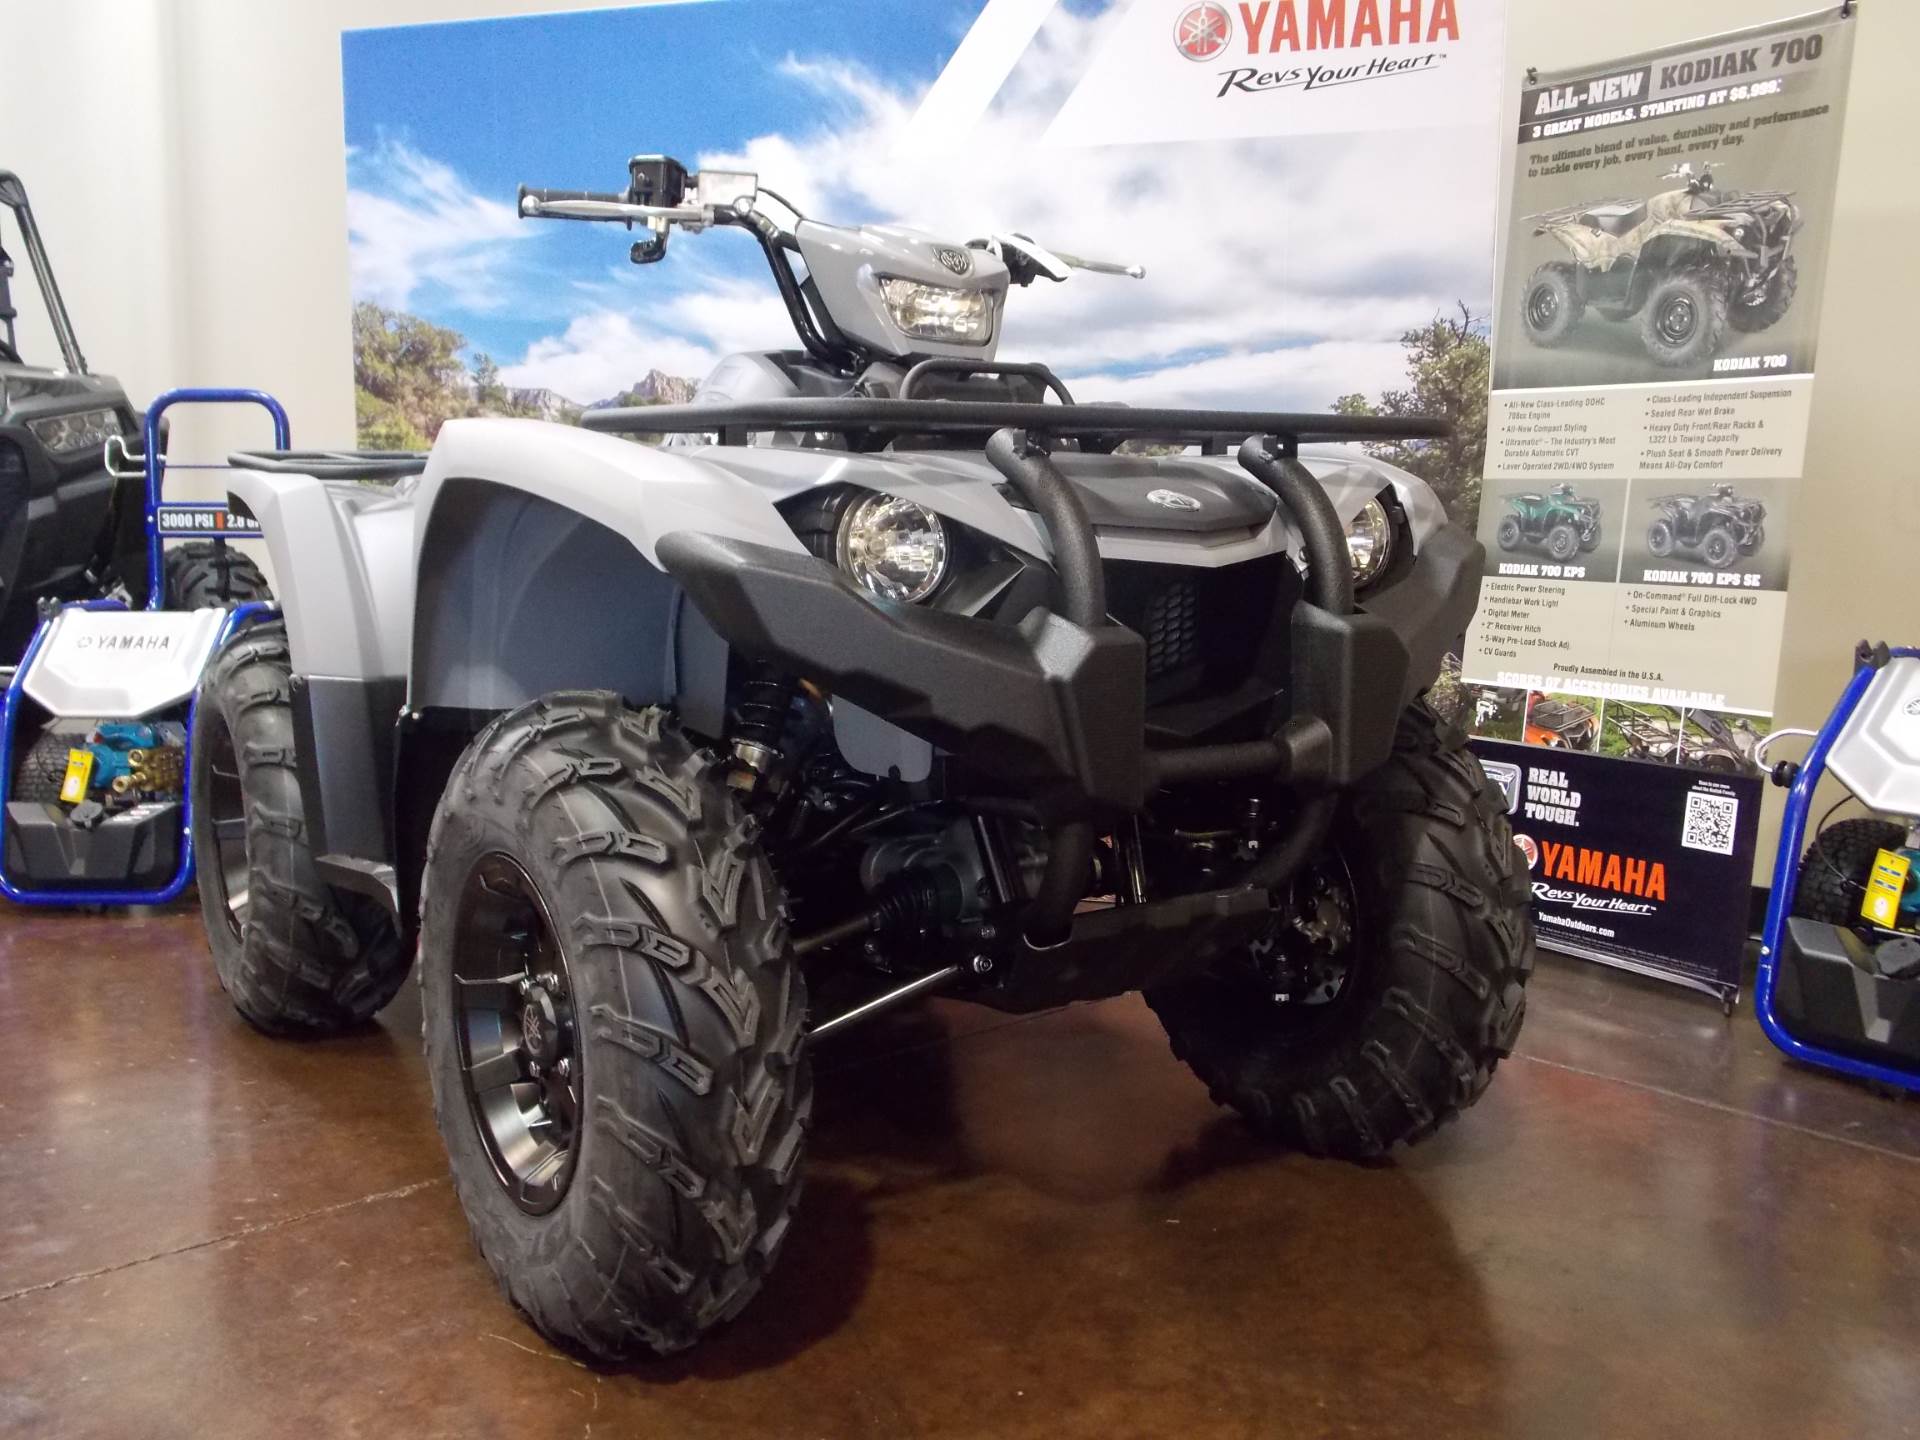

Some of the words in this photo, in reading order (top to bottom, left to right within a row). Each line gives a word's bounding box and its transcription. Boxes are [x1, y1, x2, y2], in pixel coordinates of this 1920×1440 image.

[1239, 0, 1460, 54] YAMAHA
[1535, 71, 1645, 115] ALL-NEW
[1660, 47, 1762, 90] KODIAK
[1770, 33, 1823, 68] 700
[1532, 125, 1542, 138] 3
[1543, 117, 1583, 137] GREAT
[1584, 108, 1637, 129] MODELS.
[1640, 94, 1706, 118] STARTING
[1708, 89, 1728, 106] AT
[1529, 154, 1549, 165] The
[1552, 147, 1592, 162] ultimate
[1594, 140, 1623, 154] blend
[1625, 137, 1636, 149] of
[1673, 123, 1726, 141] durability
[1729, 117, 1751, 131] and
[1753, 104, 1830, 129] performance
[1528, 168, 1538, 178] to
[1540, 161, 1571, 176] tackle
[1573, 160, 1601, 173] every
[1624, 150, 1654, 163] every
[1688, 138, 1719, 152] every
[1722, 134, 1744, 147] day.
[1713, 356, 1761, 372] KODIAK
[1763, 354, 1788, 369] 700
[1585, 397, 1606, 406] DOHC
[1703, 391, 1748, 402] Independent
[1749, 389, 1792, 400] Suspension
[1528, 411, 1551, 421] Engine
[1650, 409, 1676, 418] Sealed
[1678, 408, 1695, 417] Rear
[1697, 407, 1712, 416] Wet
[1714, 407, 1736, 415] Brake
[1533, 424, 1562, 434] Compact
[1564, 423, 1588, 433] Styling
[1649, 424, 1671, 433] Heavy
[1673, 423, 1690, 432] Duty
[1733, 420, 1755, 429] Racks
[1757, 420, 1764, 428] &
[1550, 437, 1563, 445] The
[1598, 436, 1616, 445] Most
[1680, 434, 1705, 443] Towing
[1706, 433, 1740, 443] Capacity
[1504, 449, 1530, 457] Durable
[1531, 448, 1564, 457] Automatic
[1565, 448, 1580, 457] CVT
[1646, 449, 1666, 458] Plush
[1668, 449, 1685, 457] Seat
[1687, 449, 1692, 457] &
[1694, 448, 1723, 457] Smooth
[1725, 448, 1749, 456] Power
[1750, 447, 1783, 457] Delivery
[1502, 462, 1520, 470] Lever
[1522, 462, 1552, 471] Operated
[1589, 461, 1615, 471] System
[1639, 461, 1663, 470] Means
[1664, 461, 1692, 470] All-Day
[1694, 460, 1724, 469] Comfort
[162, 513, 193, 528] 3000
[194, 513, 214, 528] PSI
[1499, 563, 1539, 576] KODIAK
[1541, 565, 1561, 577] 700
[1563, 566, 1586, 578] EPS
[1643, 569, 1688, 583] KODIAK
[1691, 571, 1714, 584] 700
[1716, 573, 1742, 585] EPS
[1743, 574, 1761, 587] SE
[1490, 583, 1514, 591] Electric
[1516, 584, 1536, 592] Power
[1538, 585, 1566, 595] Steering
[1489, 596, 1522, 605] Handlebar
[1524, 597, 1540, 606] Work
[1542, 598, 1559, 608] Light
[1687, 594, 1702, 602] Full
[1704, 594, 1737, 604] Diff-Lock
[1739, 596, 1757, 605] 4WD
[1488, 608, 1509, 618] Digital
[1511, 610, 1530, 619] Meter
[1631, 605, 1658, 614] Special
[1660, 606, 1679, 615] Paint
[1681, 607, 1686, 615] &
[1688, 608, 1721, 618] Graphics
[1495, 622, 1523, 632] Receiver
[1524, 624, 1542, 633] Hitch
[1629, 619, 1666, 629] Aluminum
[1668, 621, 1695, 631] Wheels
[98, 635, 170, 649] YAMAHA
[1507, 636, 1536, 646] Pre-Load
[1537, 639, 1557, 648] Shock
[1484, 647, 1493, 655] CV
[1494, 648, 1517, 658] Guards
[1553, 662, 1579, 673] Proudly
[1580, 665, 1618, 677] Assembled
[1619, 669, 1626, 678] in
[1628, 670, 1640, 679] the
[1641, 671, 1664, 681] U.S.A.
[1563, 679, 1649, 697] ACCESSORIES
[1527, 767, 1569, 789] REAL
[1527, 785, 1582, 809] WORLD
[1524, 802, 1580, 827] TOUGH.
[1541, 840, 1666, 902] YAMAHA
[1538, 911, 1615, 938] YamahaOutdoors.com
